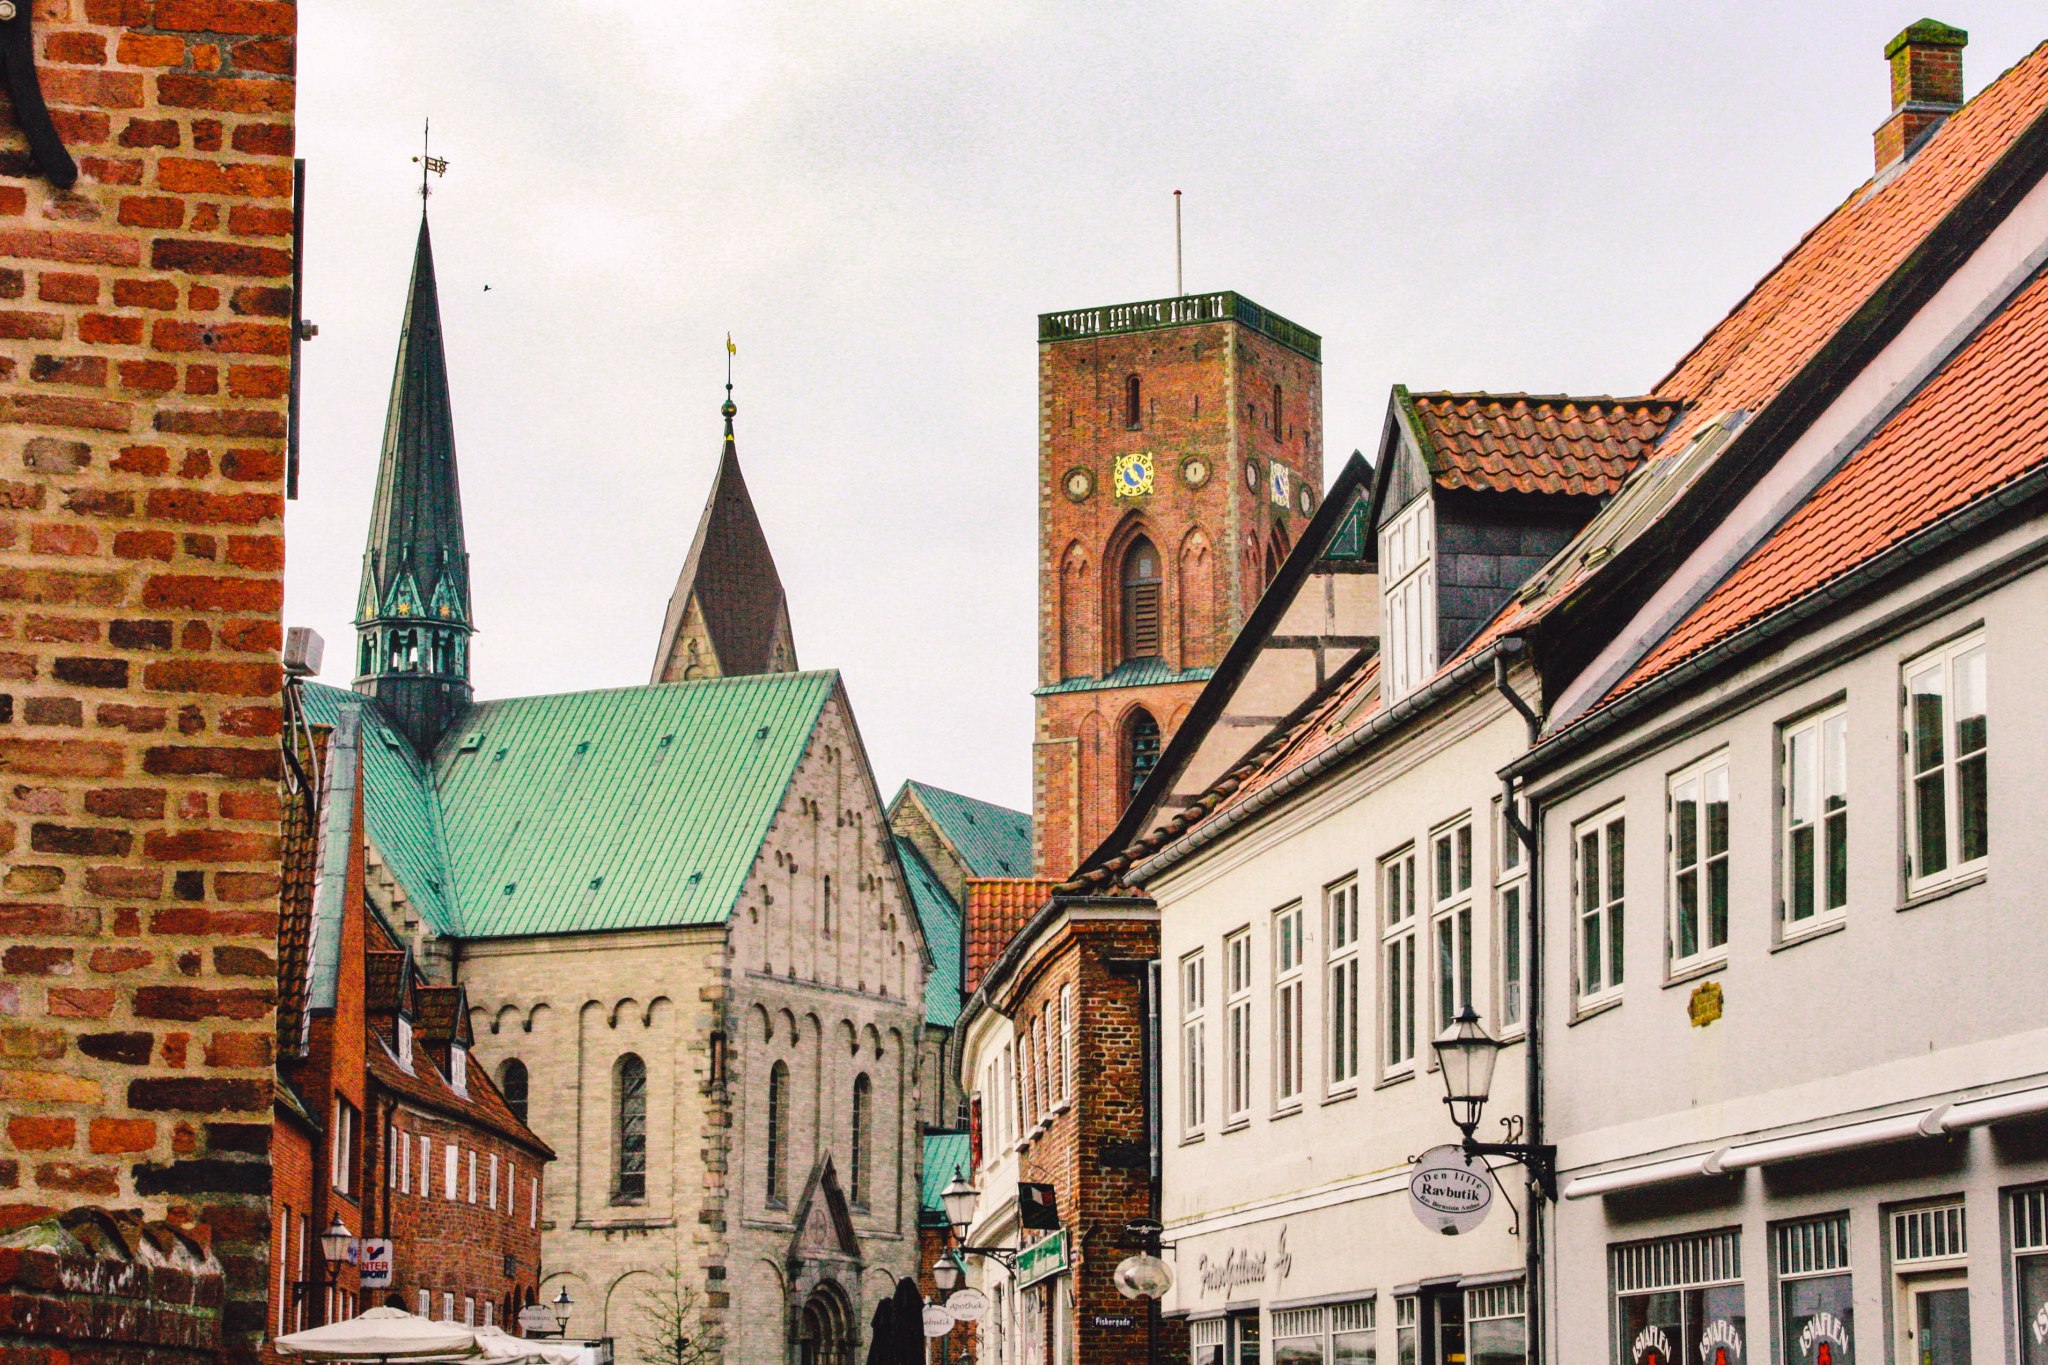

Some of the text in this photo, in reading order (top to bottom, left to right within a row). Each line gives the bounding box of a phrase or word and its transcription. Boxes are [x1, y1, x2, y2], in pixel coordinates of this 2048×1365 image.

[1423, 1172, 1482, 1189] Den lille
[1422, 1183, 1480, 1201] Ravbutik
[361, 1262, 389, 1271] NTER
[1095, 1316, 1131, 1327] Fiskergade
[1699, 1319, 1742, 1362] ISVAFLEN
[1799, 1312, 1849, 1357] ISVAFLEN
[1632, 1325, 1672, 1365] ISVAFLEN
